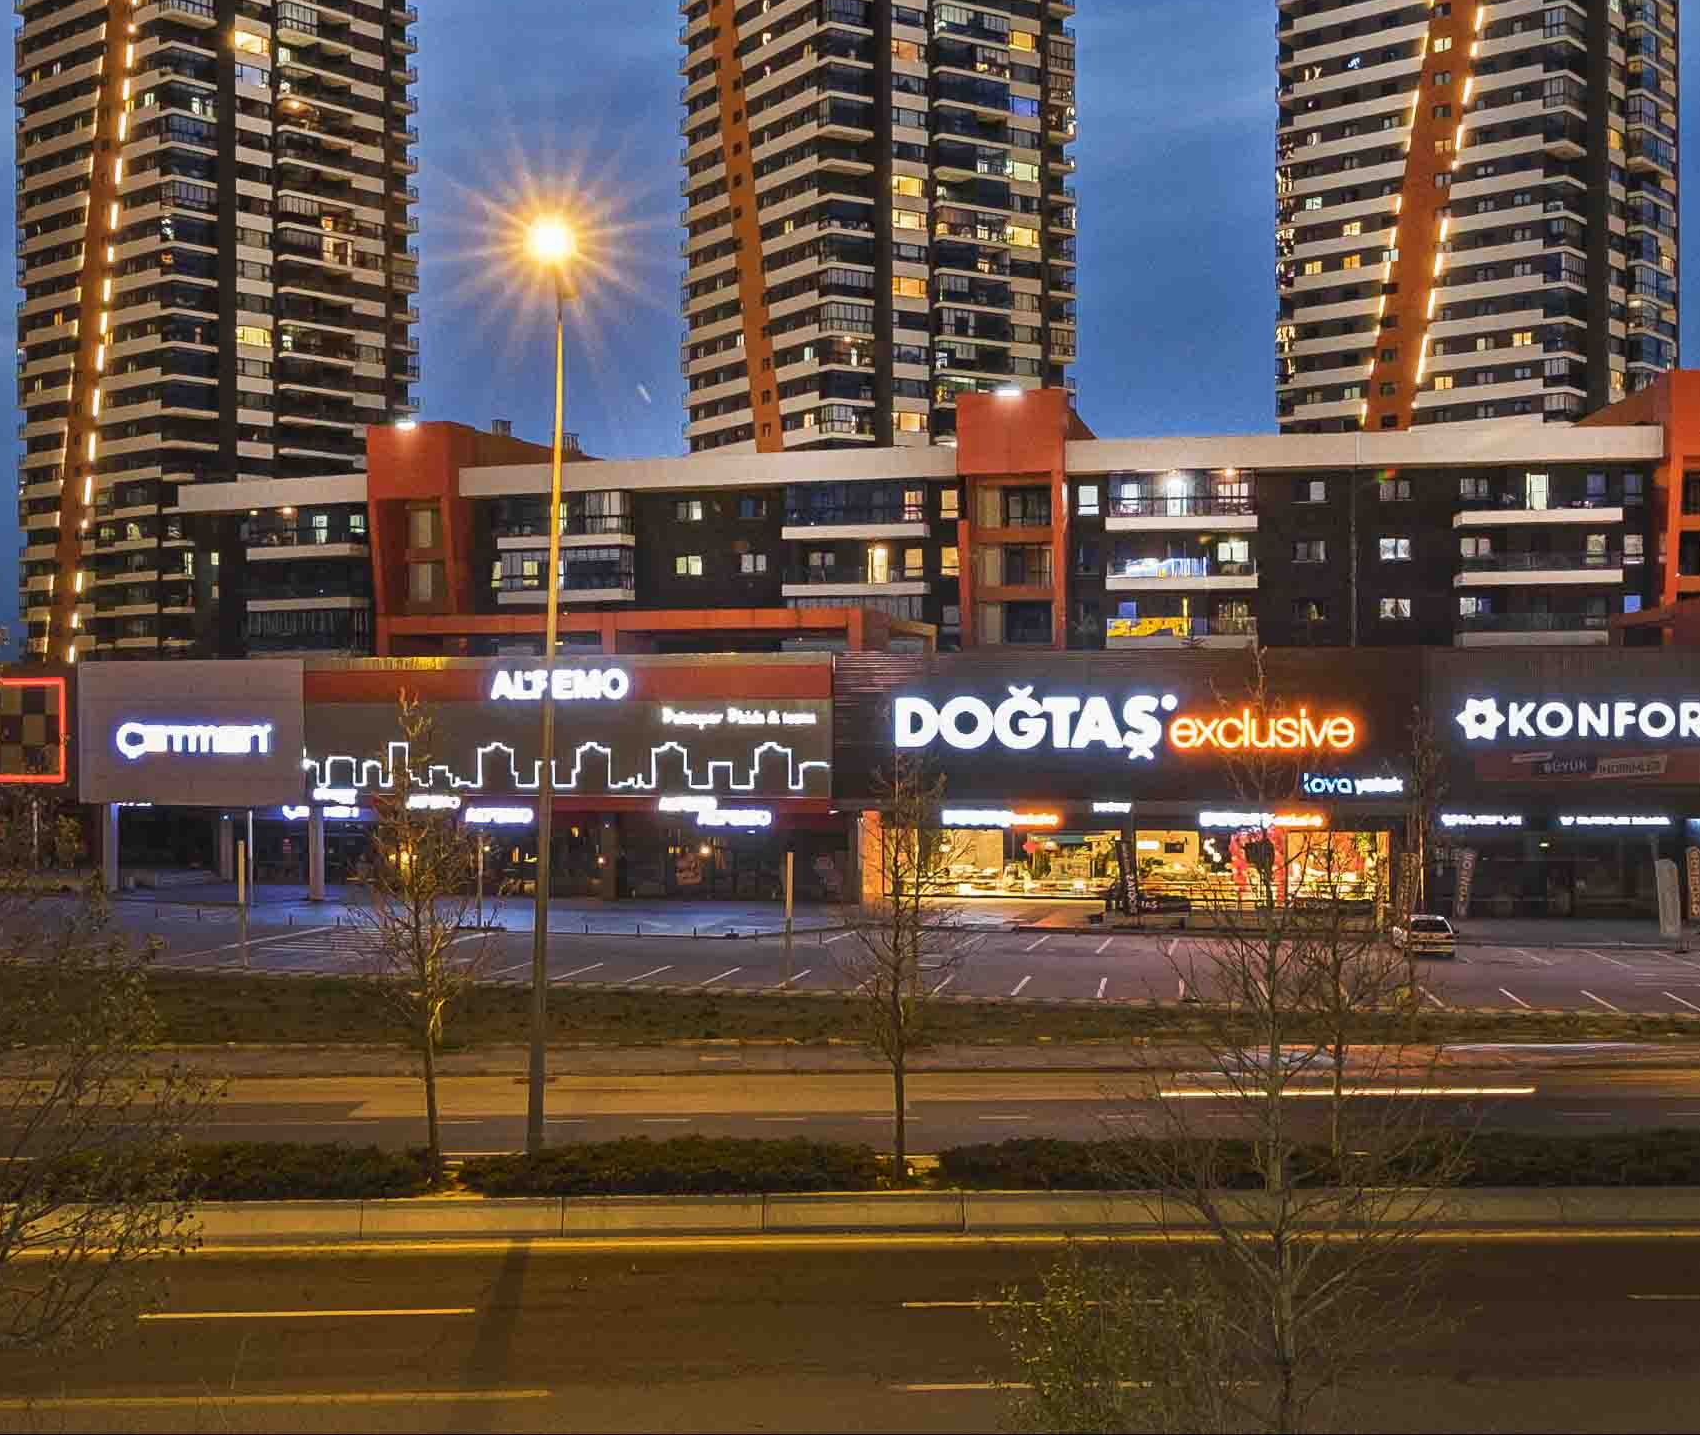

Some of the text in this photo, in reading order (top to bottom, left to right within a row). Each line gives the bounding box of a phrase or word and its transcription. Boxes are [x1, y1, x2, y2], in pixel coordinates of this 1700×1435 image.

[491, 668, 629, 701] ALFEMO
[894, 685, 1356, 760] DOĞTAŞ exclusive
